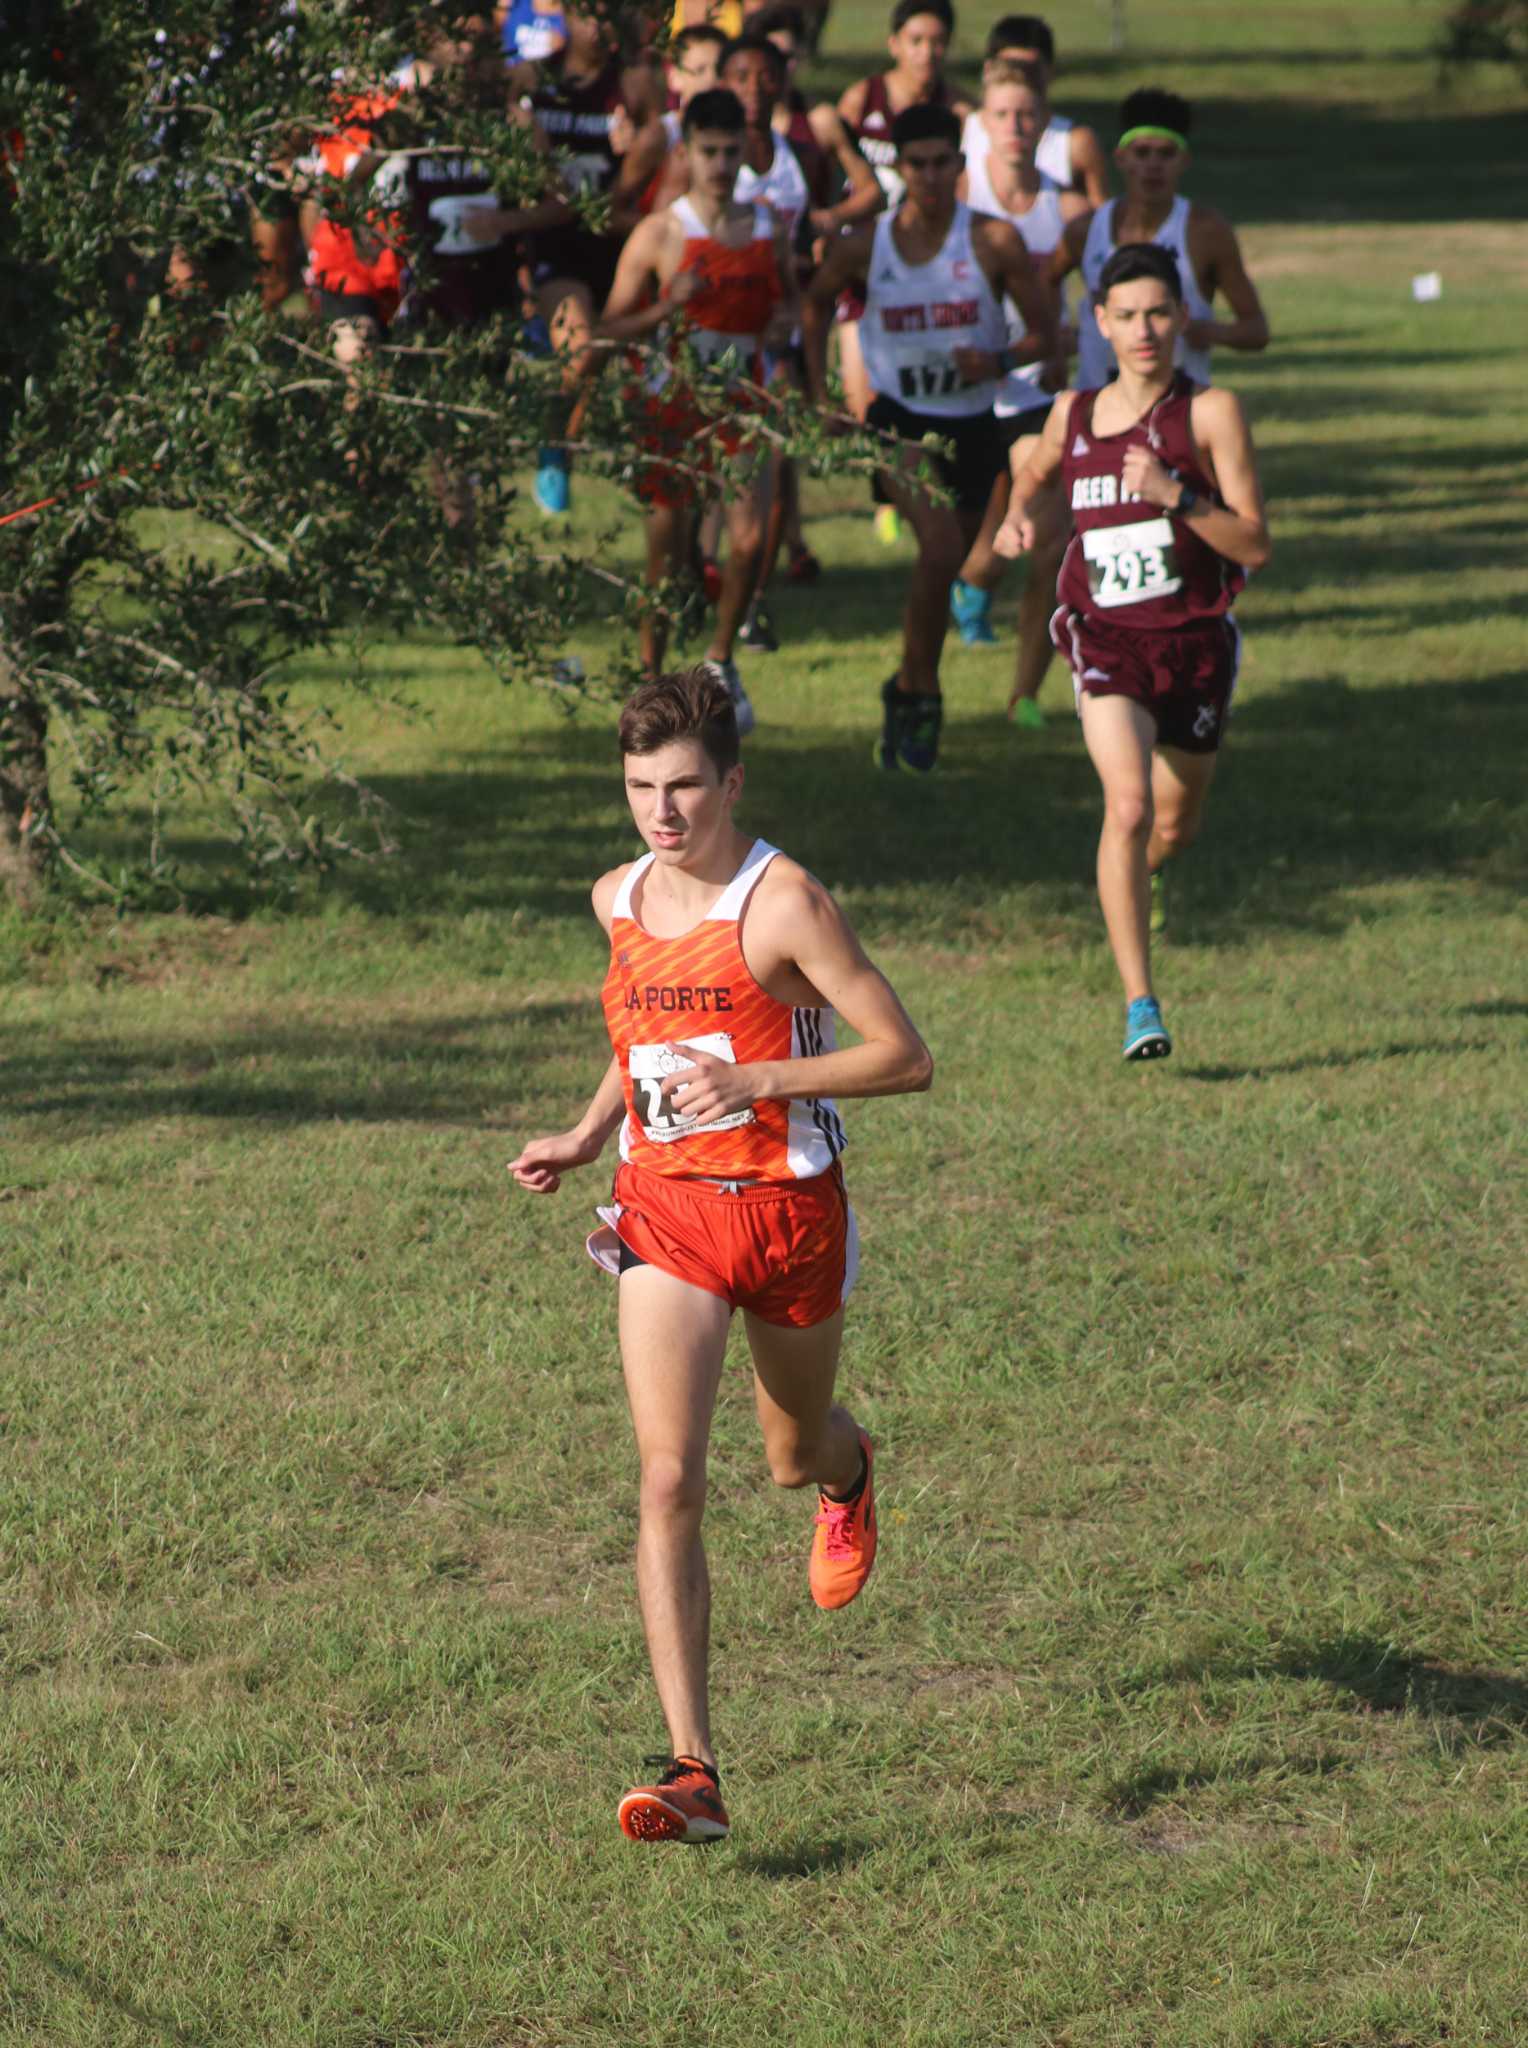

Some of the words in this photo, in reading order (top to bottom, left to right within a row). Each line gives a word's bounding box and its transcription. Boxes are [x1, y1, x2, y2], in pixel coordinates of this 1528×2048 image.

[1072, 474, 1118, 510] DEER
[1096, 546, 1168, 597] 293
[645, 986, 733, 1012] PORTE
